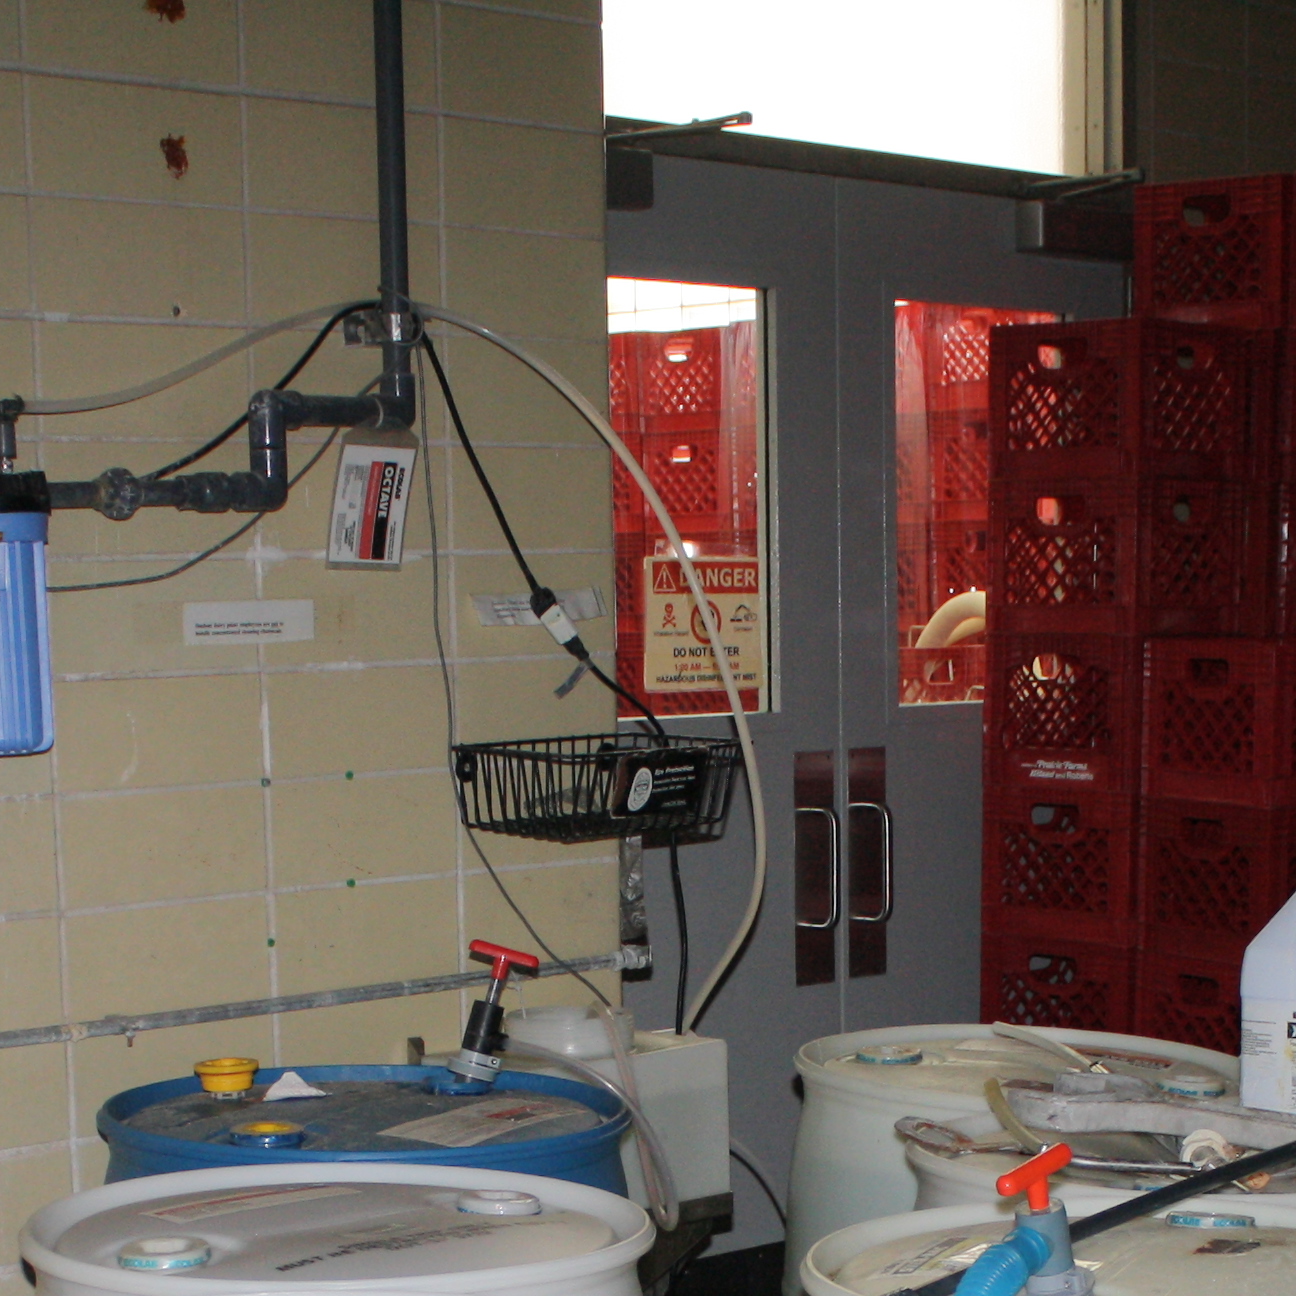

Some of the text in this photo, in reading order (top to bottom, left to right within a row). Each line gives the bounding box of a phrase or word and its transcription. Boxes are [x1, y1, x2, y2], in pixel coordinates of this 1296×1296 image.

[377, 466, 395, 518] OCTAVE
[674, 646, 740, 658] DO NOT ETER
